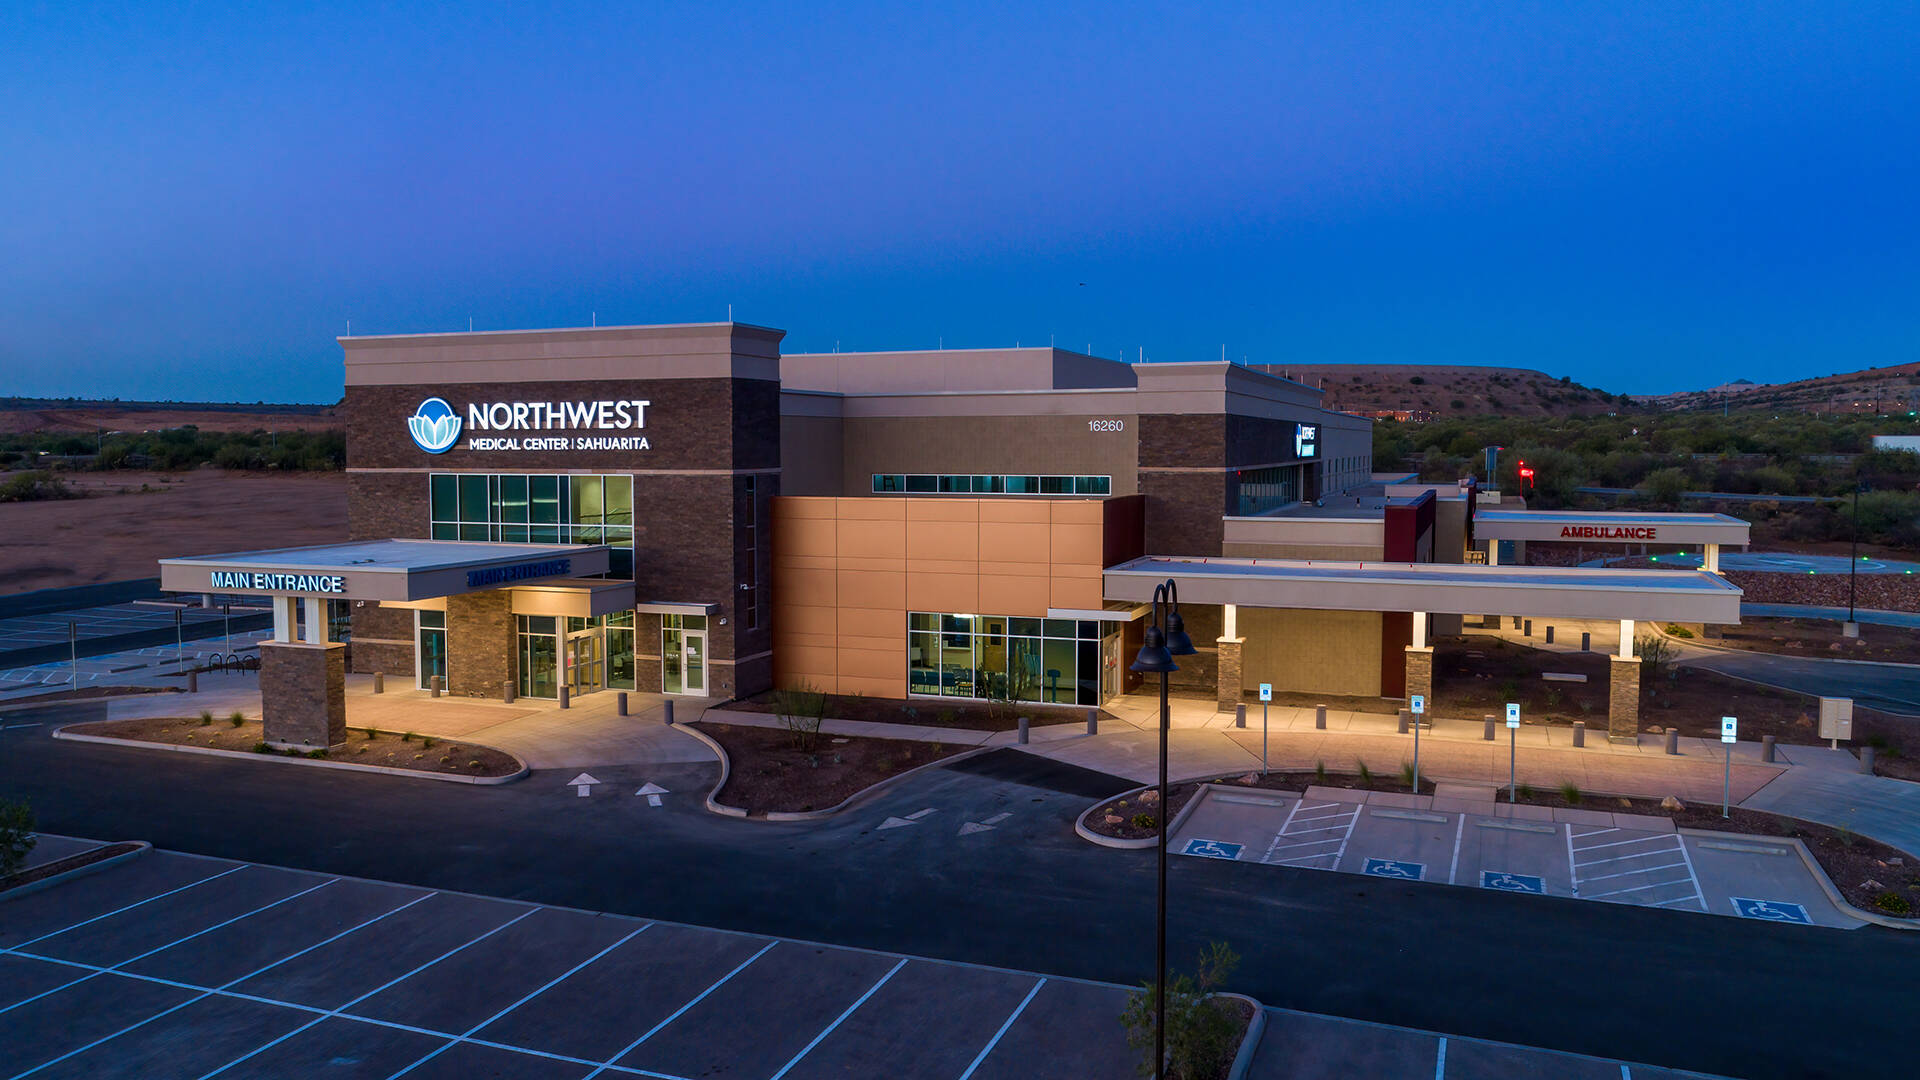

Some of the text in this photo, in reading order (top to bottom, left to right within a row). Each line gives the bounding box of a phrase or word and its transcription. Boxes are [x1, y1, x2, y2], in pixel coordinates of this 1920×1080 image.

[469, 401, 650, 430] NORTHWEST
[1088, 420, 1124, 432] 16260
[469, 437, 650, 450] MEDICAL CENTER SAHUARITA
[1560, 526, 1657, 539] AMBULANCE
[467, 559, 571, 587] MAIN ENTRANCE
[211, 572, 344, 593] MAIN ENTRANCE
